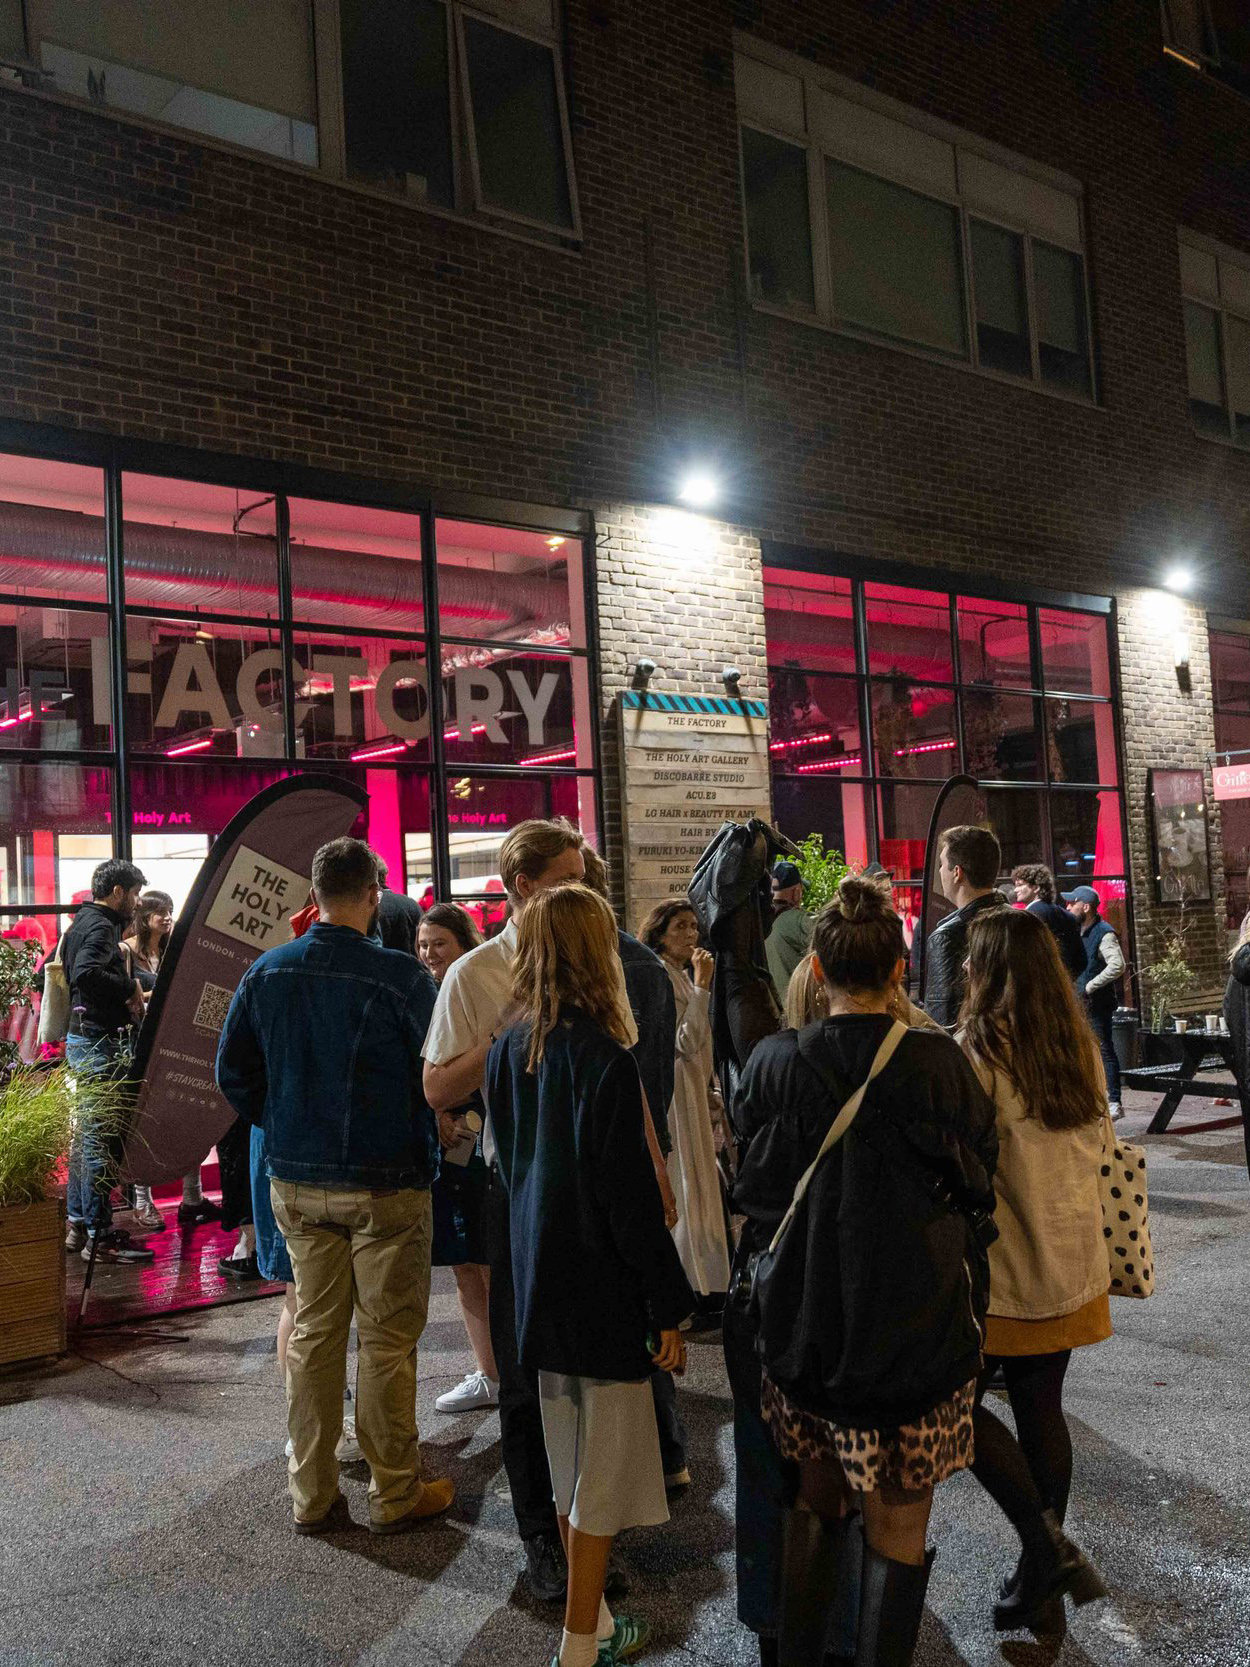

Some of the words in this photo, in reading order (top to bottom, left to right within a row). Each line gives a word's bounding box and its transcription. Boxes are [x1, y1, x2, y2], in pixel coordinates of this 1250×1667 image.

[91, 636, 559, 745] FACTORY
[667, 716, 685, 726] THE
[688, 717, 727, 728] FACTORY
[646, 752, 664, 762] THE
[666, 753, 691, 763] HOLY
[692, 755, 710, 764] ART
[711, 756, 749, 765] GALLERY
[653, 771, 710, 782] DISCOBARRE
[713, 773, 745, 783] STUDIO
[685, 791, 717, 800] ACU.E8
[133, 811, 164, 827] Holy
[168, 811, 191, 824] Art
[461, 811, 486, 827] Holy
[488, 812, 507, 824] Art
[645, 808, 657, 818] LG
[659, 809, 681, 818] HAIR
[690, 809, 724, 818] BEAUTY
[725, 810, 736, 818] BY
[737, 810, 756, 819] AMY
[680, 828, 703, 837] HAIR
[705, 828, 717, 837] BY
[638, 846, 673, 855] FURUKI
[660, 865, 691, 874] HOUSE
[252, 865, 289, 897] THE
[669, 884, 690, 893] ROO
[231, 883, 291, 921] HOLY
[229, 911, 274, 940] ART
[197, 937, 236, 959] LONDON
[242, 957, 255, 966] AT
[159, 1047, 216, 1069] WWW.THEHOLY
